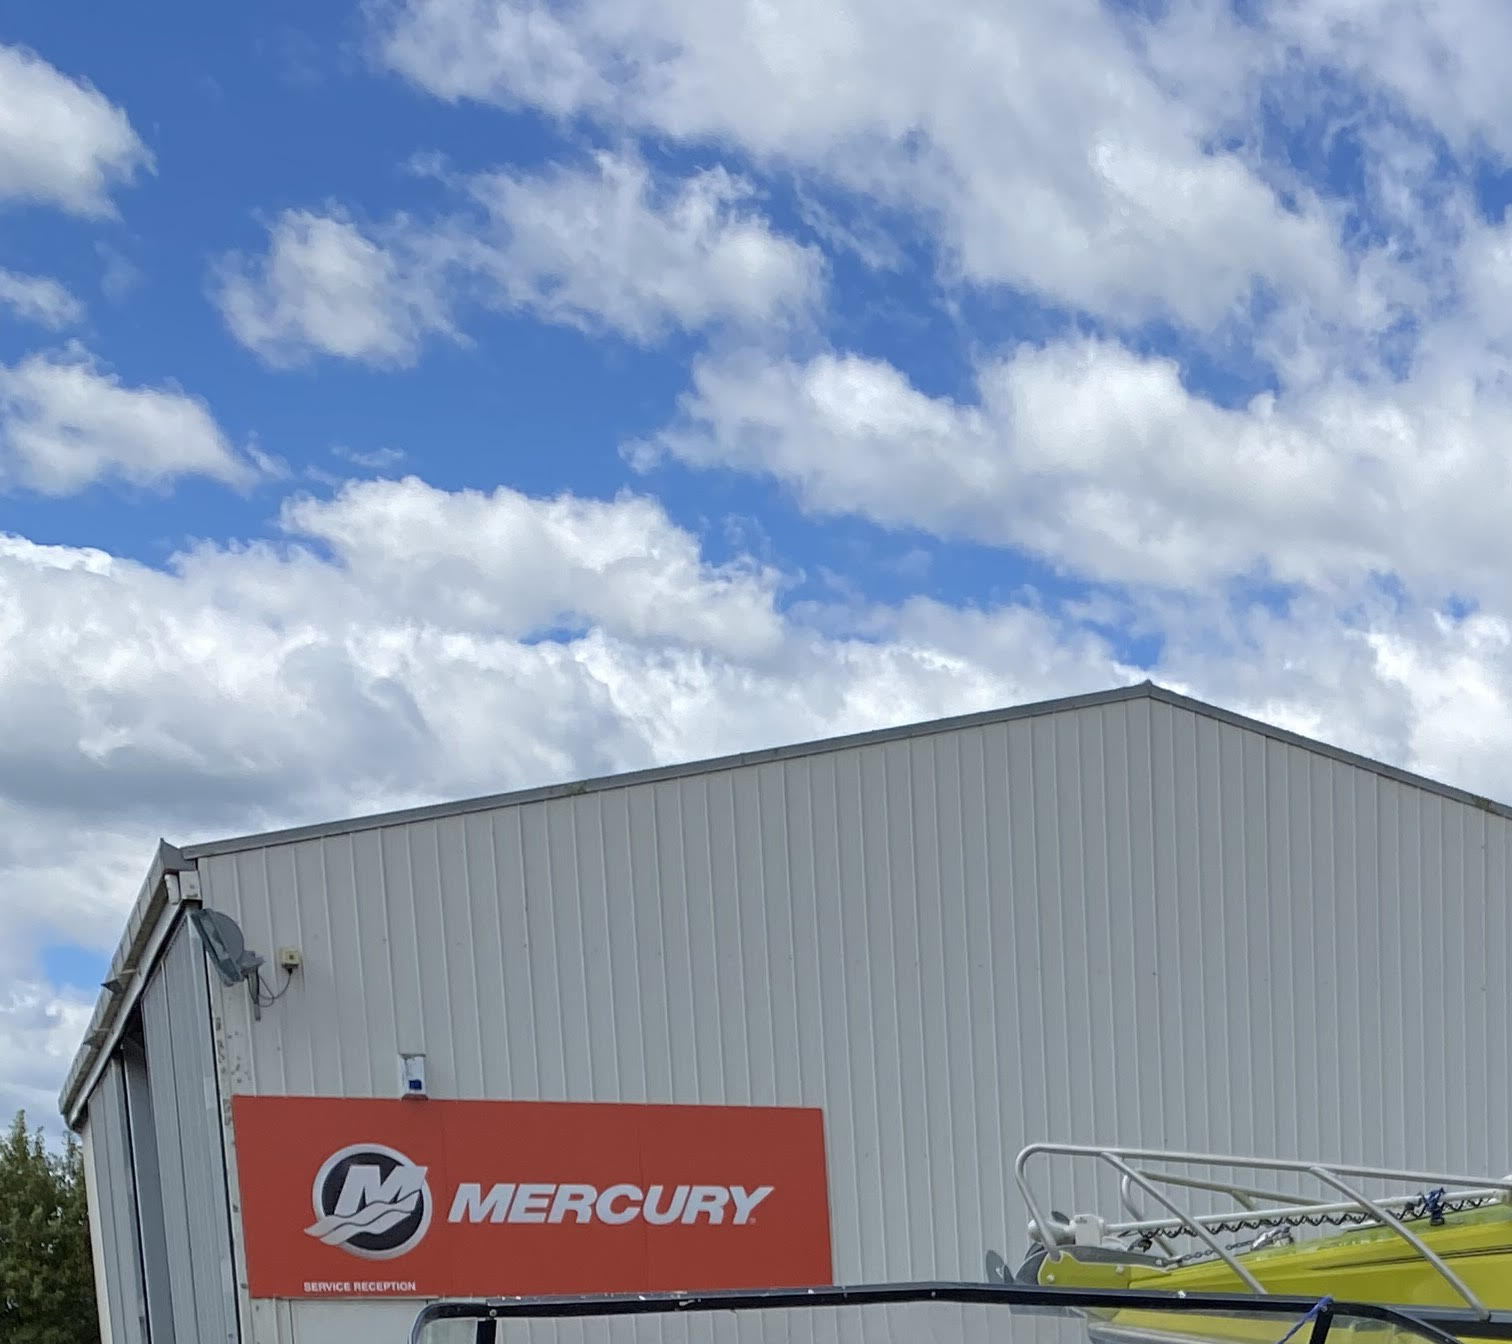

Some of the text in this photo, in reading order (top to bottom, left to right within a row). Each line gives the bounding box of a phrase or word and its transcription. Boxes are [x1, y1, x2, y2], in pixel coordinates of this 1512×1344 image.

[448, 1183, 774, 1225] MERCURY
[303, 1280, 417, 1292] SERVICE RECEPTION
